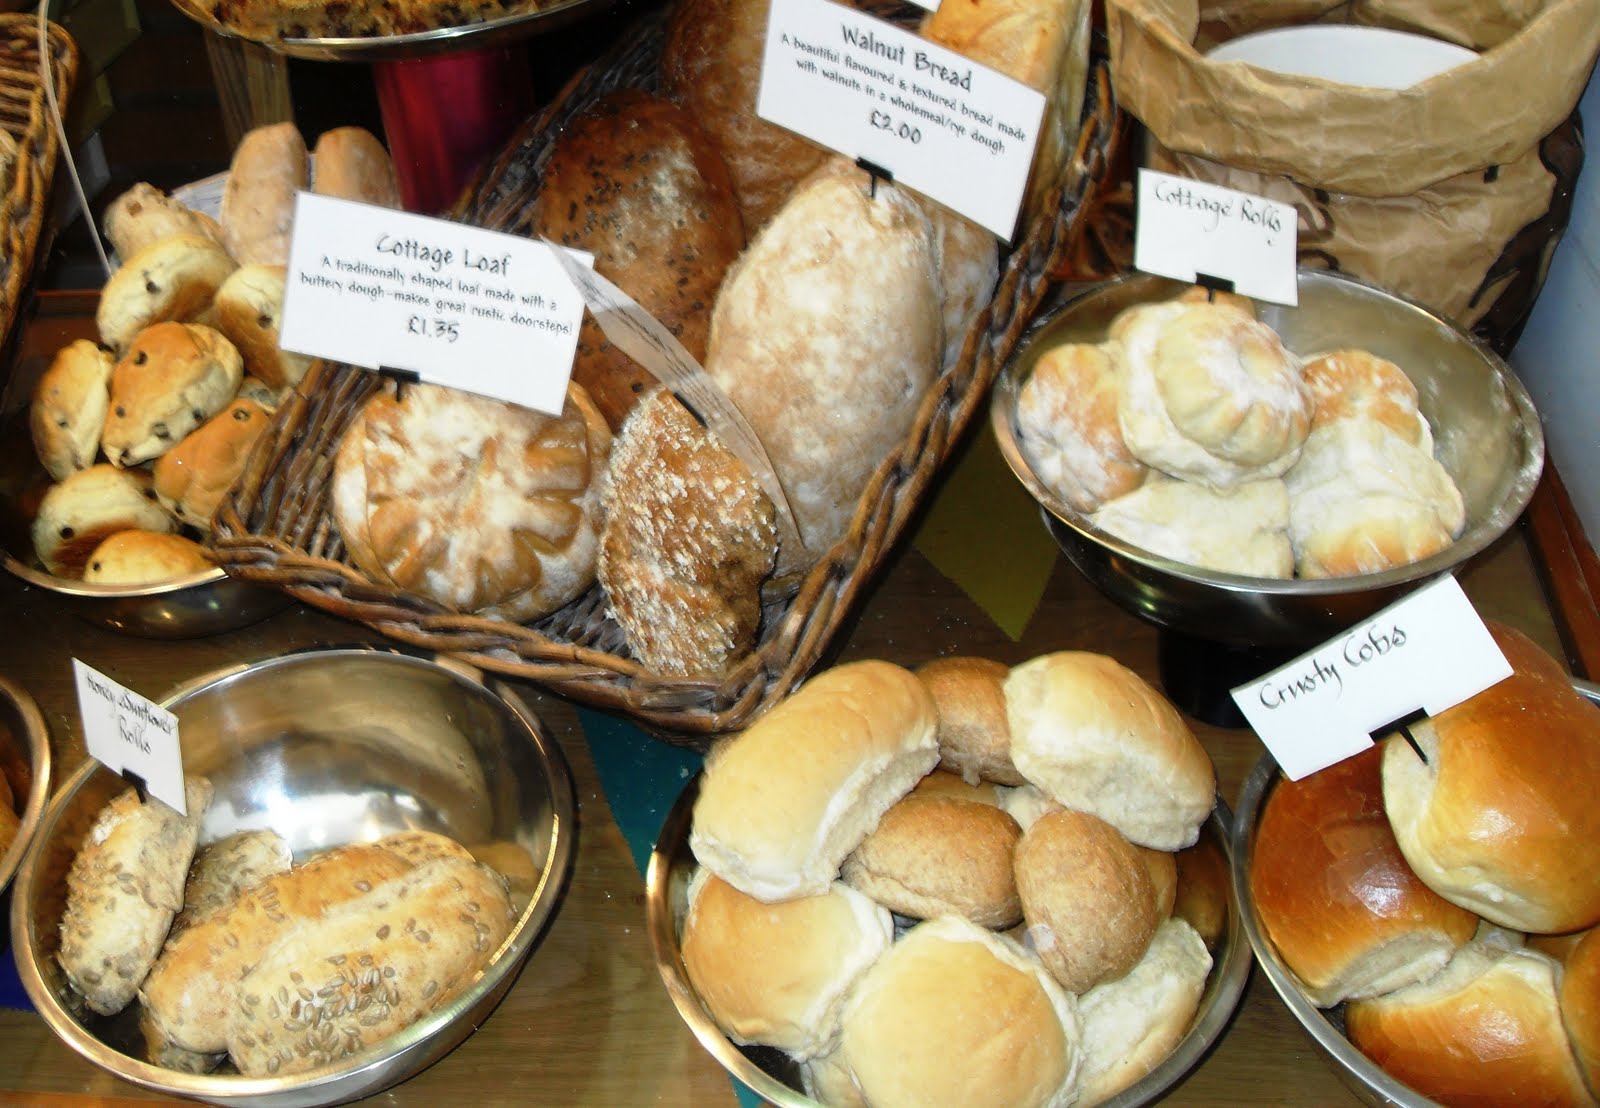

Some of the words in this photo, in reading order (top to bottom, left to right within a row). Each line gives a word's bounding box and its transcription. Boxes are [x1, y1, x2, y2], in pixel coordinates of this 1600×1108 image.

[841, 24, 906, 65] Walnut
[914, 52, 973, 93] Bread
[781, 33, 791, 45] A
[794, 37, 840, 64] beautiful
[845, 55, 894, 85] flavoured
[899, 79, 908, 92] &
[912, 82, 956, 112] textured
[962, 103, 993, 127] bread
[998, 120, 1026, 142] made
[796, 59, 817, 74] with
[822, 70, 861, 92] walnuts
[866, 84, 876, 98] in
[879, 92, 886, 102] a
[971, 129, 1005, 156] dough
[870, 109, 922, 145] £2.00
[1155, 181, 1233, 232] Cottage
[1240, 199, 1282, 233] Rolls
[376, 233, 454, 272] Cottage
[464, 249, 512, 276] Loaf
[301, 271, 343, 293] buttery
[436, 299, 466, 320] great
[472, 306, 506, 322] rustic
[510, 311, 573, 336] doorsteps!
[321, 255, 332, 268] A
[335, 259, 406, 285] traditionally
[411, 273, 453, 292] shaped
[458, 279, 481, 297] loaf
[485, 285, 516, 302] made
[521, 292, 546, 309] with
[550, 300, 558, 311] a
[407, 315, 460, 343] £1.35
[1259, 659, 1343, 709] Crusty
[1343, 624, 1407, 667] Cobs
[86, 671, 116, 718] Honey
[119, 714, 152, 755] Rolls
